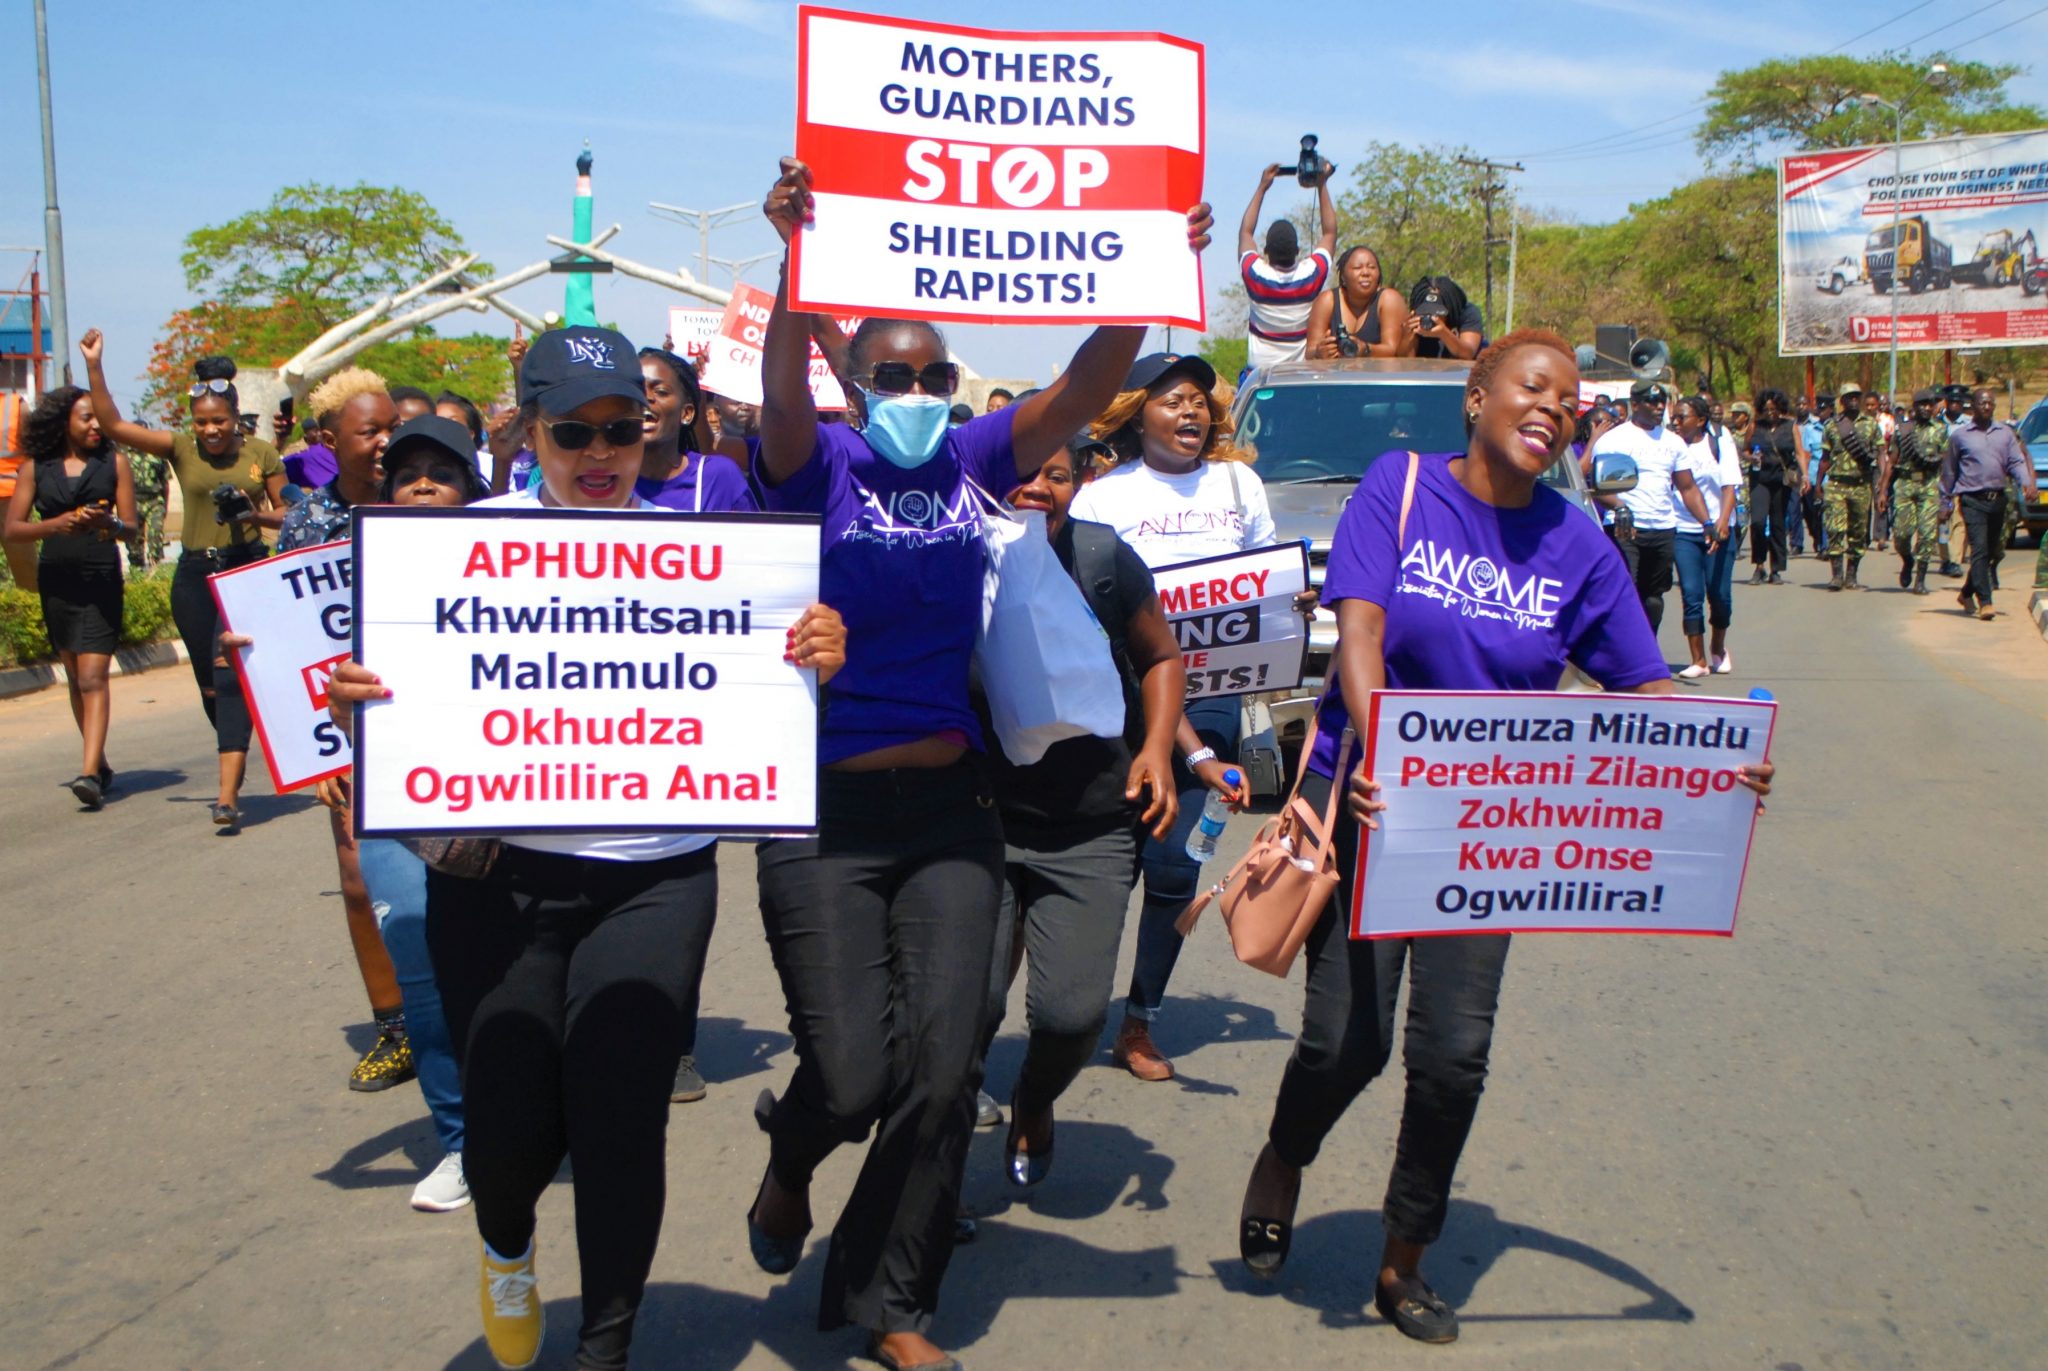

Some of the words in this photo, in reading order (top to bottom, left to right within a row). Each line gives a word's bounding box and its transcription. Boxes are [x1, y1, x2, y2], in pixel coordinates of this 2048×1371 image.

[901, 41, 1113, 89] MOTHERS,
[879, 83, 1136, 127] GUARDIANS
[902, 139, 1110, 208] STOP
[1869, 190, 1897, 202] FOR
[1901, 186, 1943, 199] EVERY
[1946, 181, 2014, 196] BUSINESS
[1923, 171, 1958, 184] YOUR
[1960, 168, 1985, 181] SET
[1988, 166, 2006, 178] OF
[2008, 161, 2048, 177] WHEE
[888, 221, 1124, 262] SHIELDING
[914, 267, 1097, 304] RAPISTS!
[684, 315, 723, 325] TOMO
[462, 541, 724, 581] APHUNGU
[1401, 539, 1562, 615] AWOME
[1159, 569, 1270, 614] MERCY
[435, 596, 752, 636] Khwimitsani
[471, 652, 718, 691] Malamulo
[314, 721, 352, 757] S
[482, 708, 703, 746] Okhudza
[1398, 710, 1575, 744] Oweruza
[1589, 713, 1750, 750] Milandu
[405, 764, 648, 812] Ogwililira
[666, 765, 778, 801] Ana!
[1400, 754, 1576, 788] Perekani
[1586, 756, 1736, 798] Zilango
[1457, 797, 1663, 831] Zokhwima
[1458, 841, 1541, 871] Kwa
[1554, 840, 1653, 872] Onse
[1435, 881, 1664, 920] Ogwililira!
